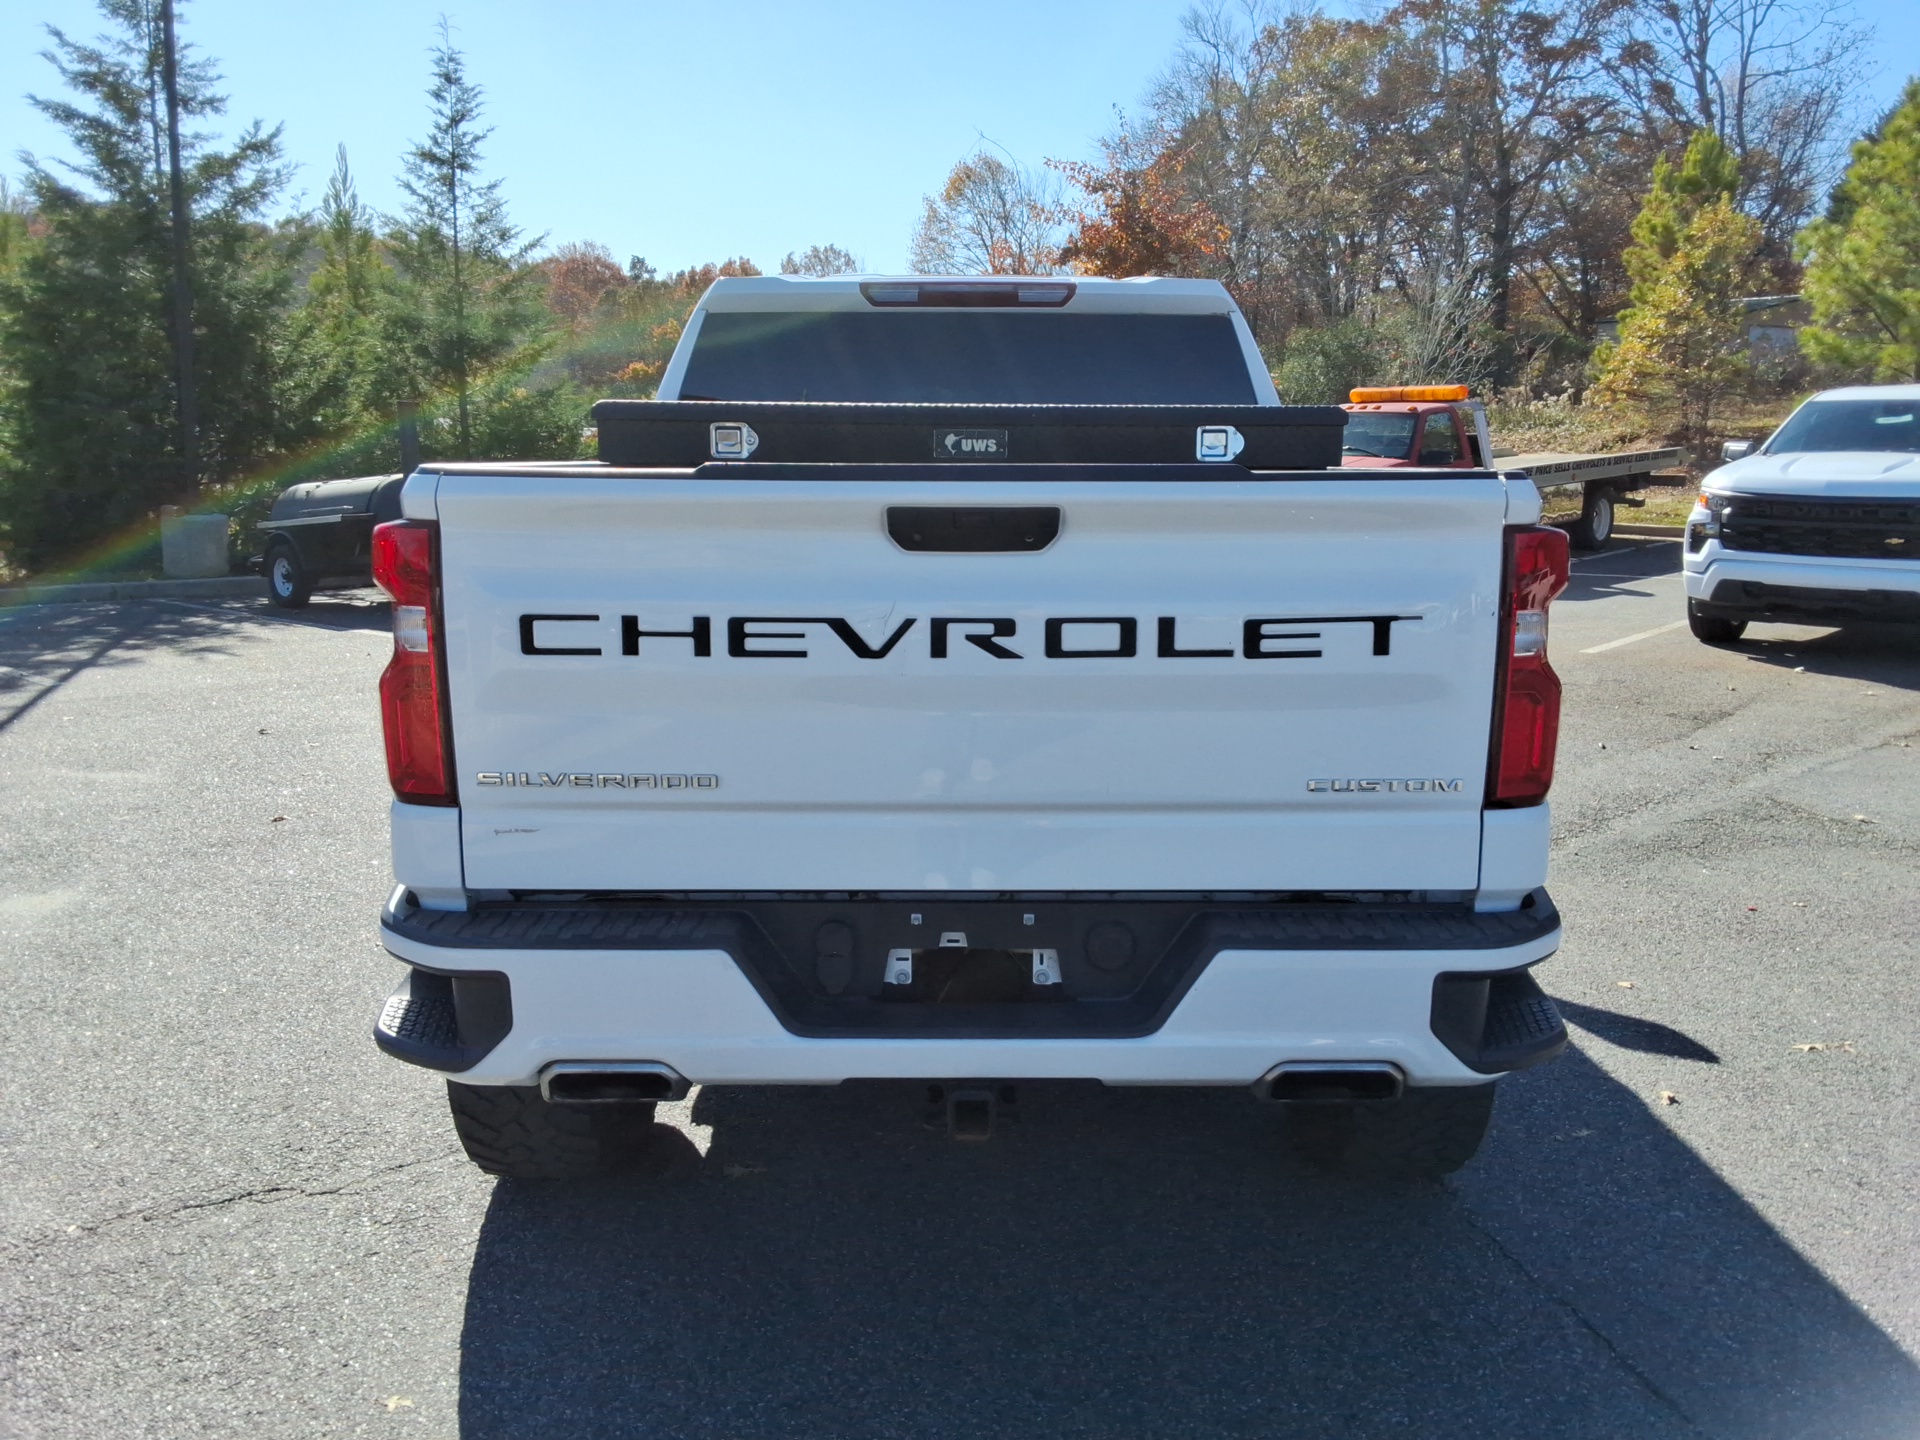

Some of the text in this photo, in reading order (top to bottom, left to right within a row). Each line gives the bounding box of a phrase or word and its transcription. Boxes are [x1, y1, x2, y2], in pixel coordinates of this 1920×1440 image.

[961, 438, 997, 452] UWS
[1535, 464, 1552, 476] PRICE
[1553, 462, 1571, 473] SELLS
[519, 614, 1424, 659] CHEVROLET
[476, 771, 719, 790] SILVERADO
[1306, 778, 1464, 793] CUSTOM
